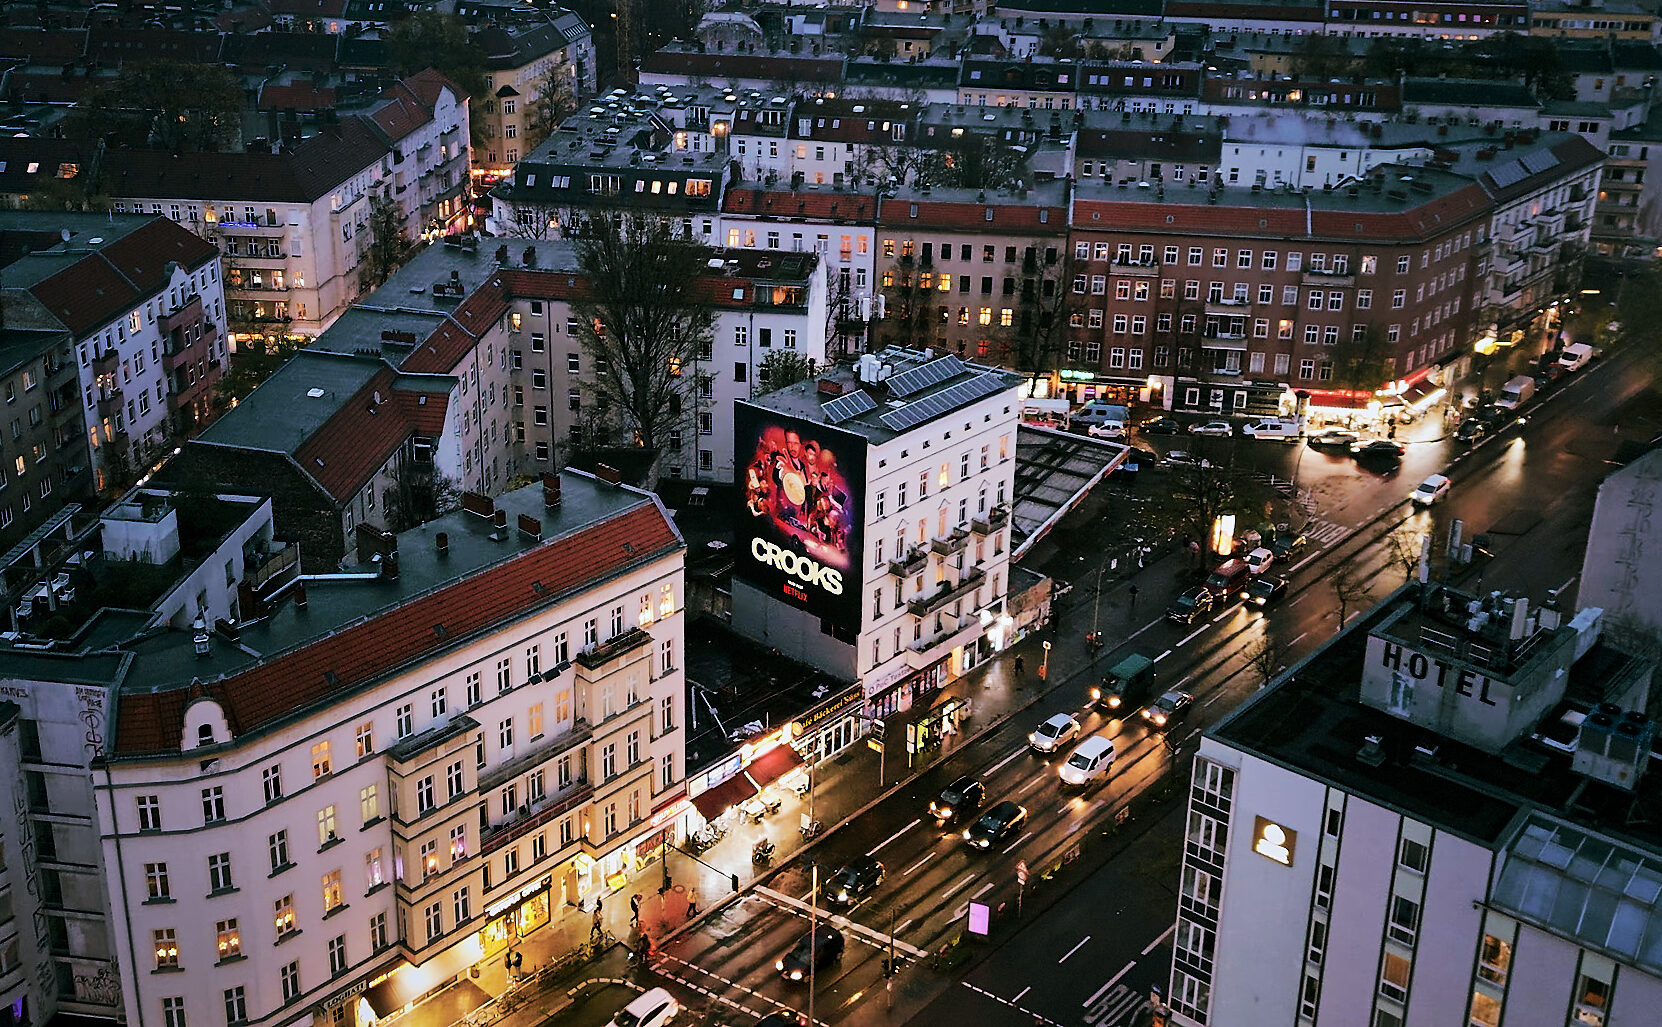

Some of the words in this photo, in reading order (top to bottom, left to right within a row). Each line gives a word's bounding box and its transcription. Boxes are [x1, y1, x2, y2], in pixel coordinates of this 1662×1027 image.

[751, 537, 844, 596] CROOKS
[783, 583, 808, 603] NETFLIX
[1383, 641, 1497, 706] HOTEL
